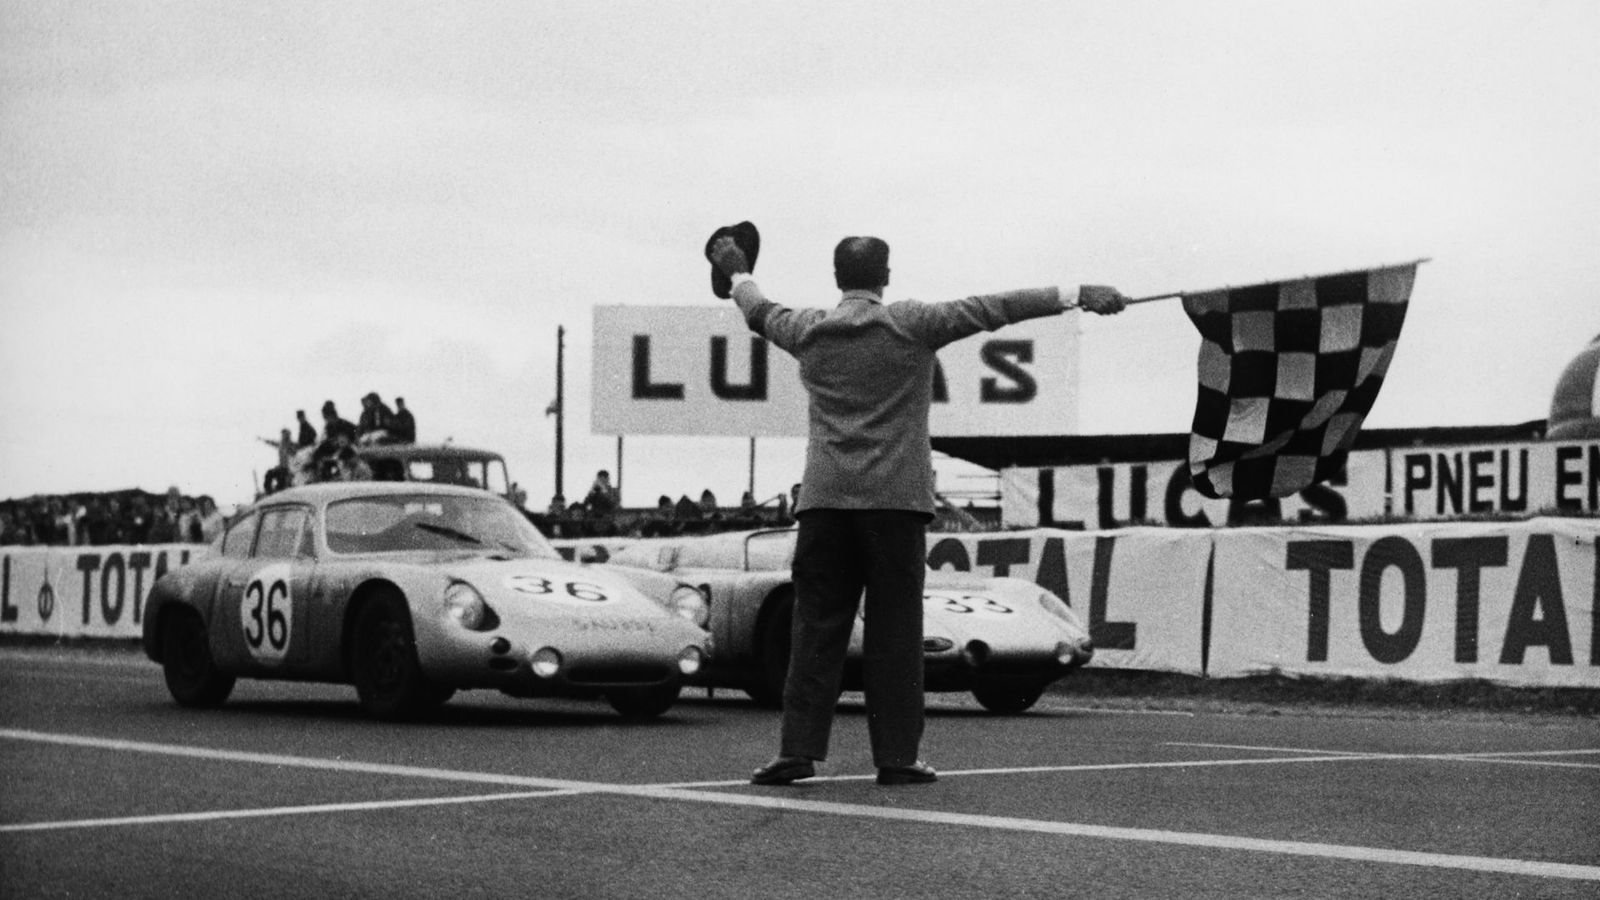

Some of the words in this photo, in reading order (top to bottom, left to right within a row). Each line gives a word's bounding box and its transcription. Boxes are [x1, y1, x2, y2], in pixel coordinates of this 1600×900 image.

[632, 335, 1037, 402] LUS
[1038, 455, 1347, 527] LUCS
[1404, 448, 1528, 516] PNEU
[77, 551, 189, 625] TOT
[245, 579, 288, 650] 36
[512, 575, 608, 601] 36
[923, 595, 1014, 613] 33
[1286, 534, 1600, 665] TOTA
